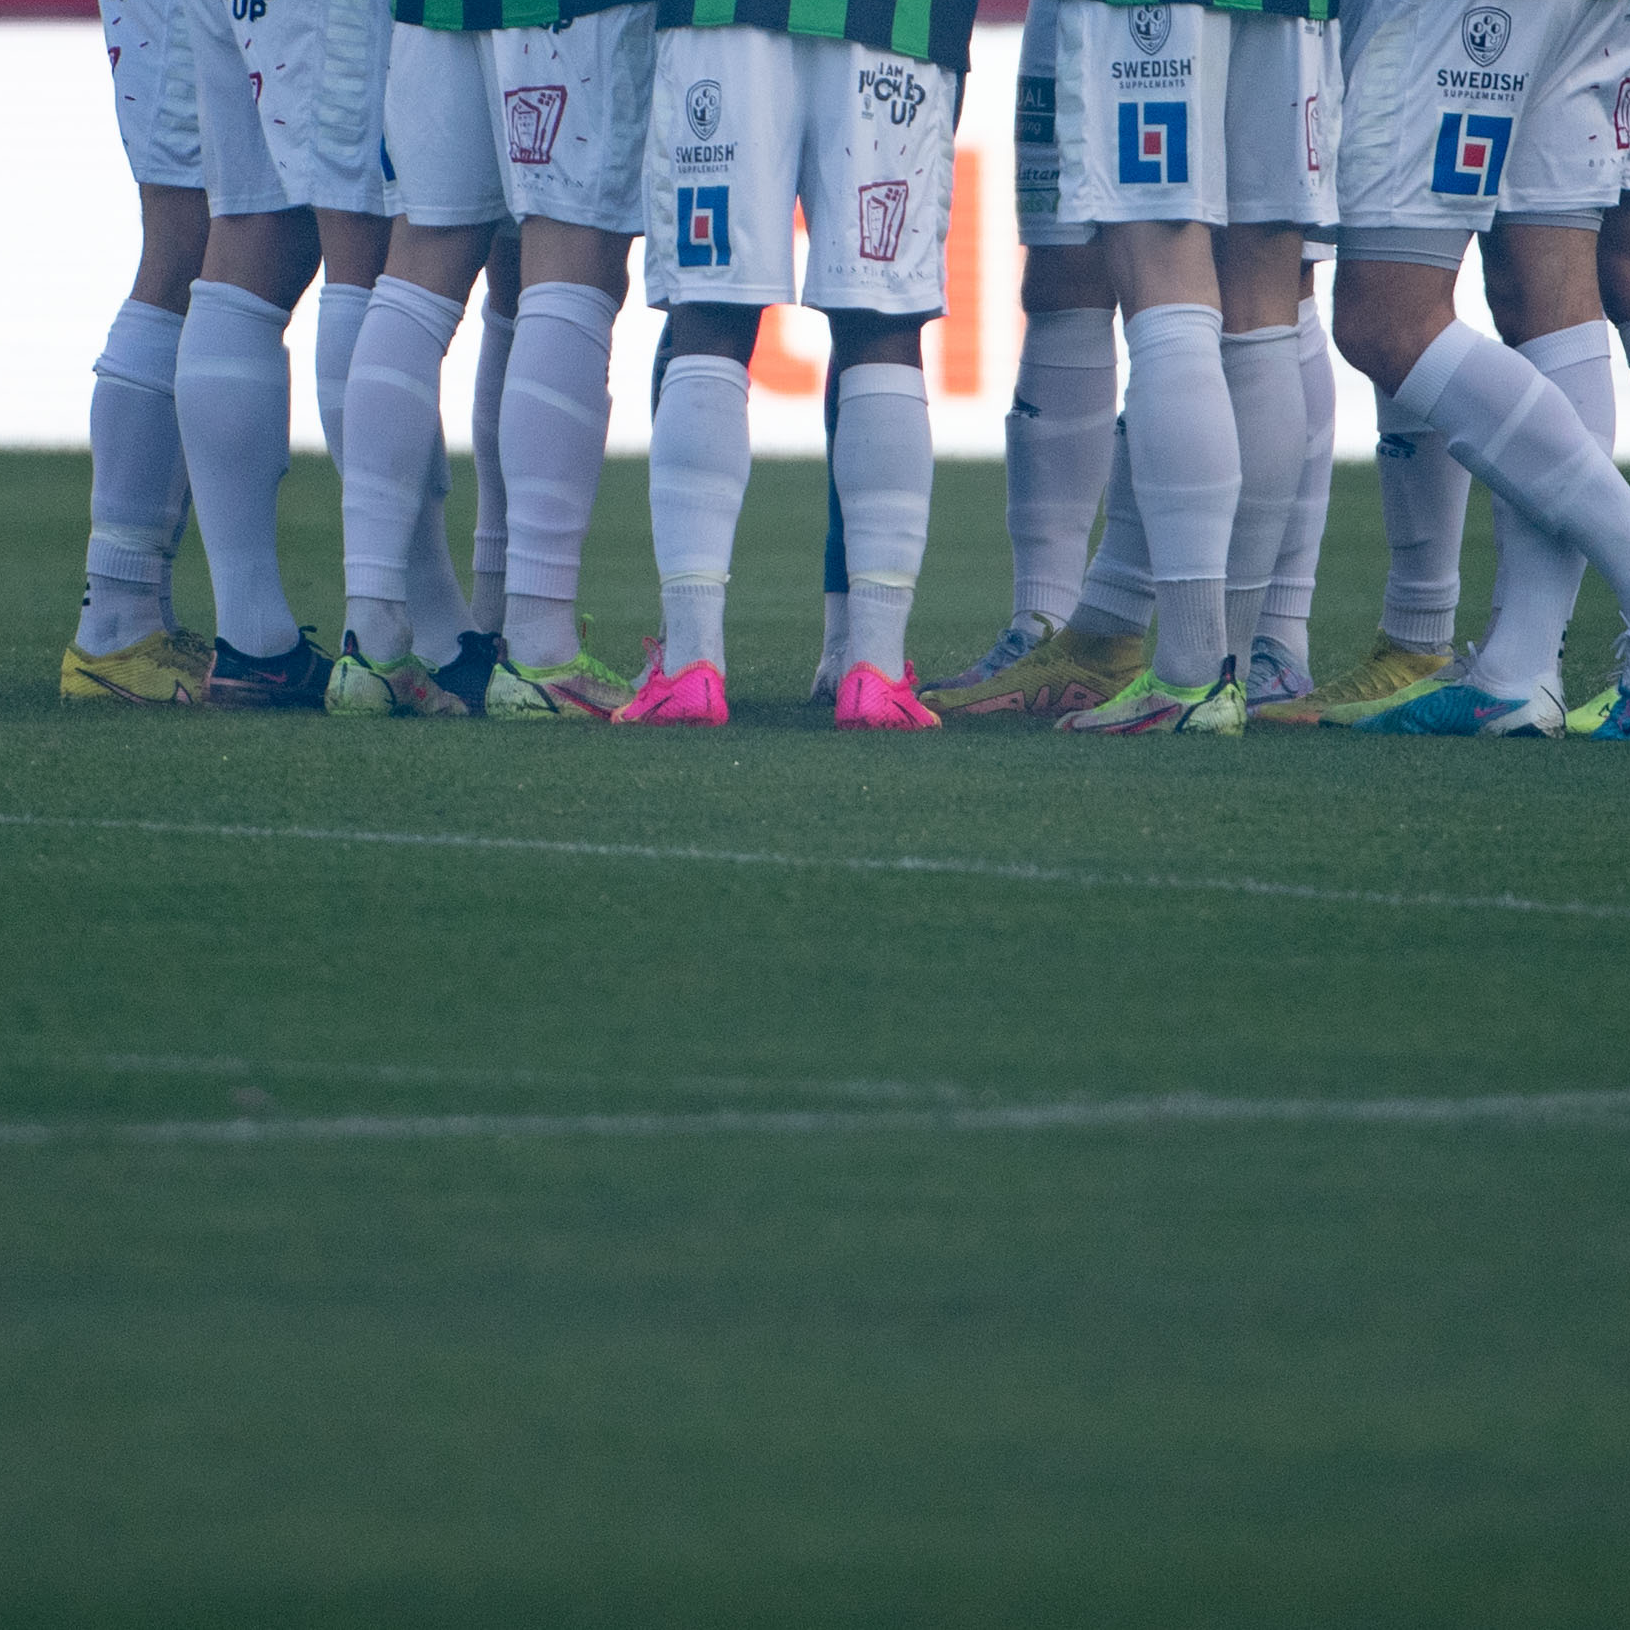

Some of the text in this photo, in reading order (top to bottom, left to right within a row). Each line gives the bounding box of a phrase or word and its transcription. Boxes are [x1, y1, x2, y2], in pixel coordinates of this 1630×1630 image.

[886, 64, 904, 78] AM
[1111, 59, 1192, 79] SWEDISH
[1119, 79, 1186, 89] SUPPLEMENTS
[1437, 69, 1525, 92] SWEDISH
[1443, 89, 1515, 102] SUPPLEMENTS
[891, 99, 917, 129] UP
[675, 144, 735, 164] SWEDISH
